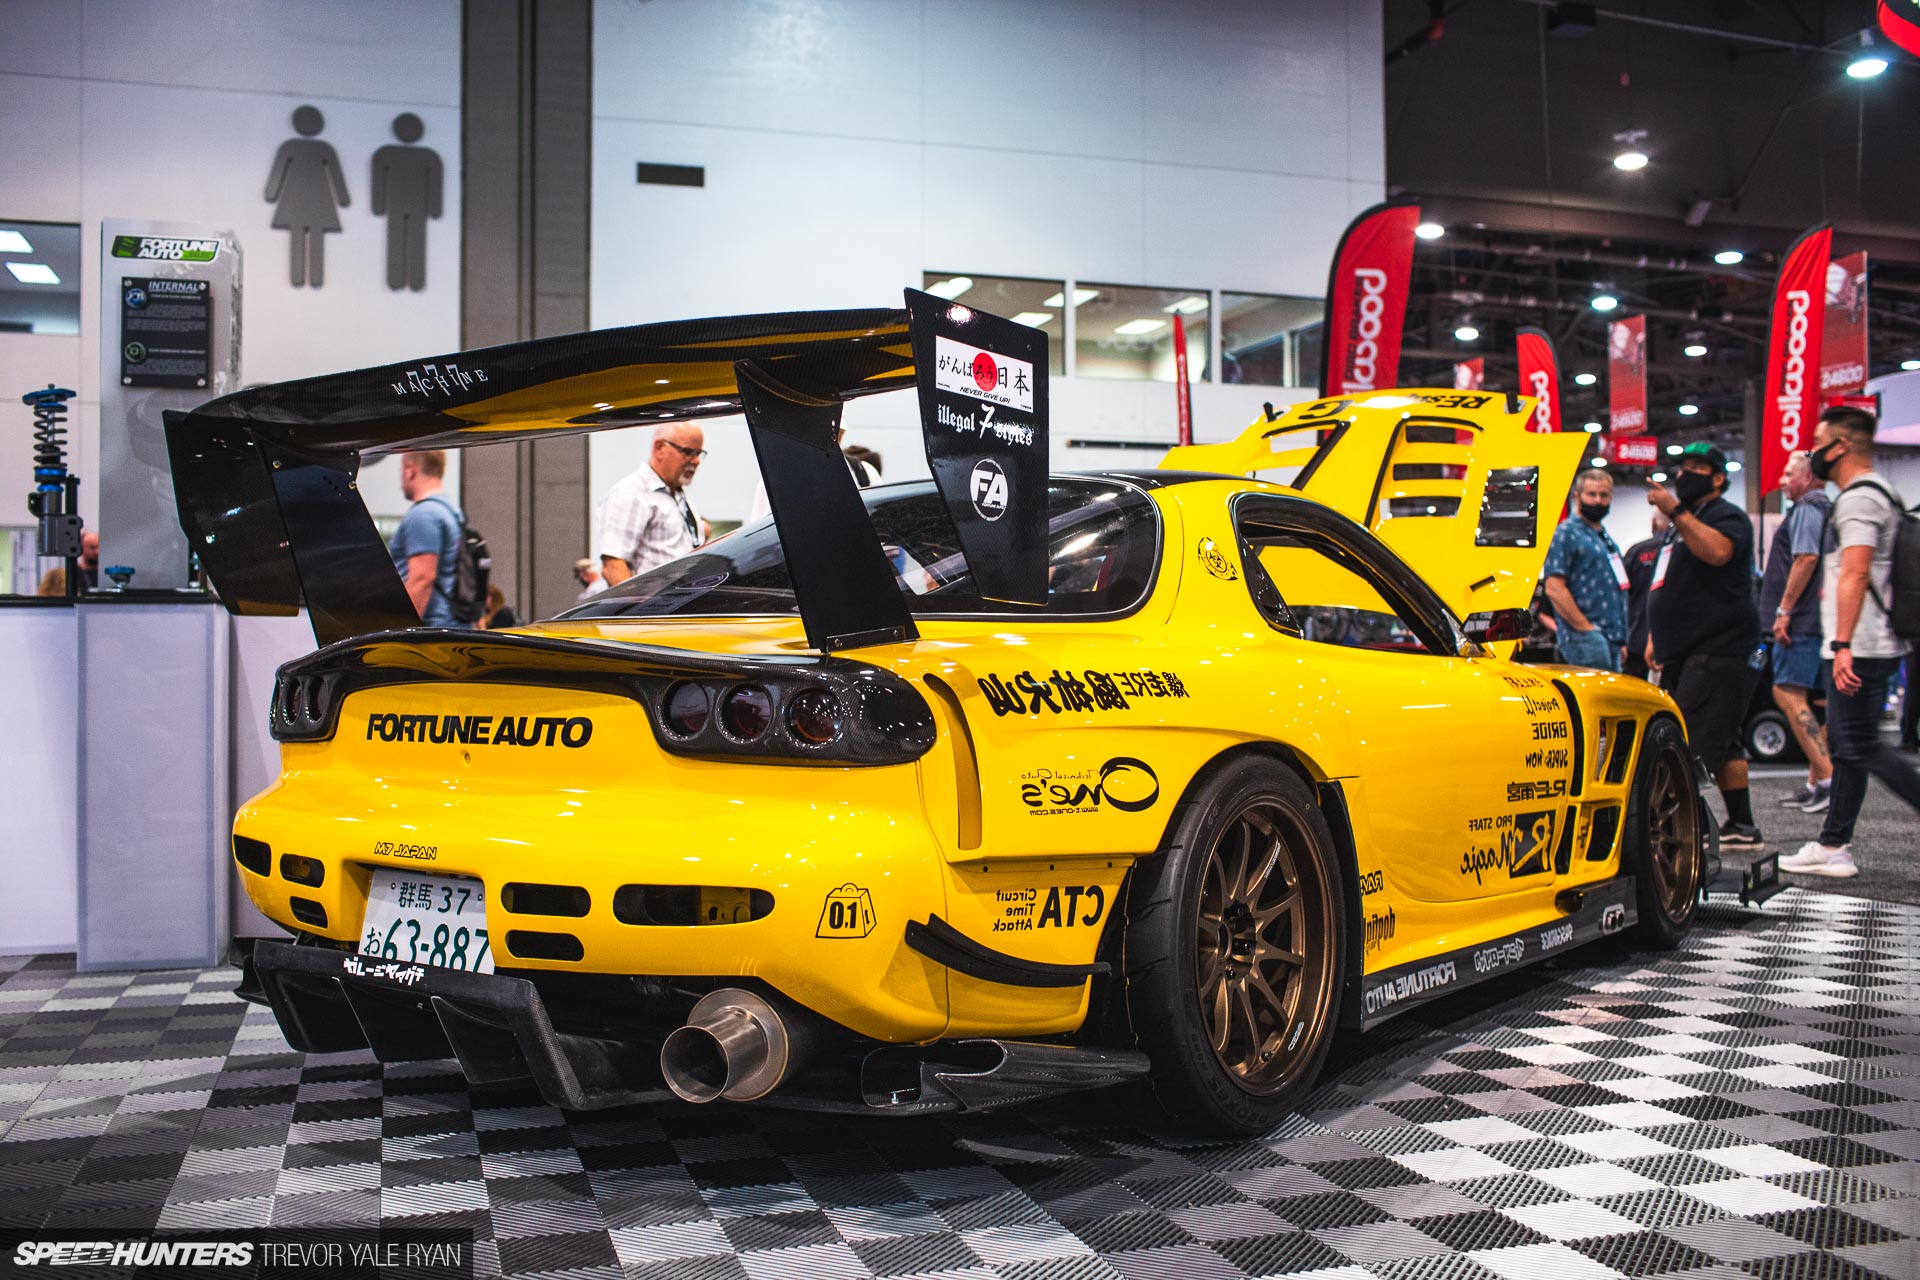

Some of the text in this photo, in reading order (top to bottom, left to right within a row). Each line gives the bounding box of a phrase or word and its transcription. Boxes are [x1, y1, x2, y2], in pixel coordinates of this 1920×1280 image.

[137, 249, 183, 259] AUTO
[141, 238, 217, 251] FORTUNE
[148, 281, 198, 293] INTERNAL
[1342, 268, 1387, 396] lwood
[938, 354, 1030, 396] がんばろう日本
[1777, 290, 1809, 451] wilwood
[959, 386, 982, 397] NEVER
[983, 392, 1001, 401] GIVE
[937, 403, 975, 433] illegal
[979, 403, 996, 439] 7
[971, 469, 1008, 508] FA
[366, 713, 593, 748] FORTUNE AUTO
[374, 842, 437, 860] M7 JAPAN
[399, 882, 472, 916] 群馬 37
[381, 917, 490, 973] 63-887
[343, 956, 425, 986] ガレージヤマグチ
